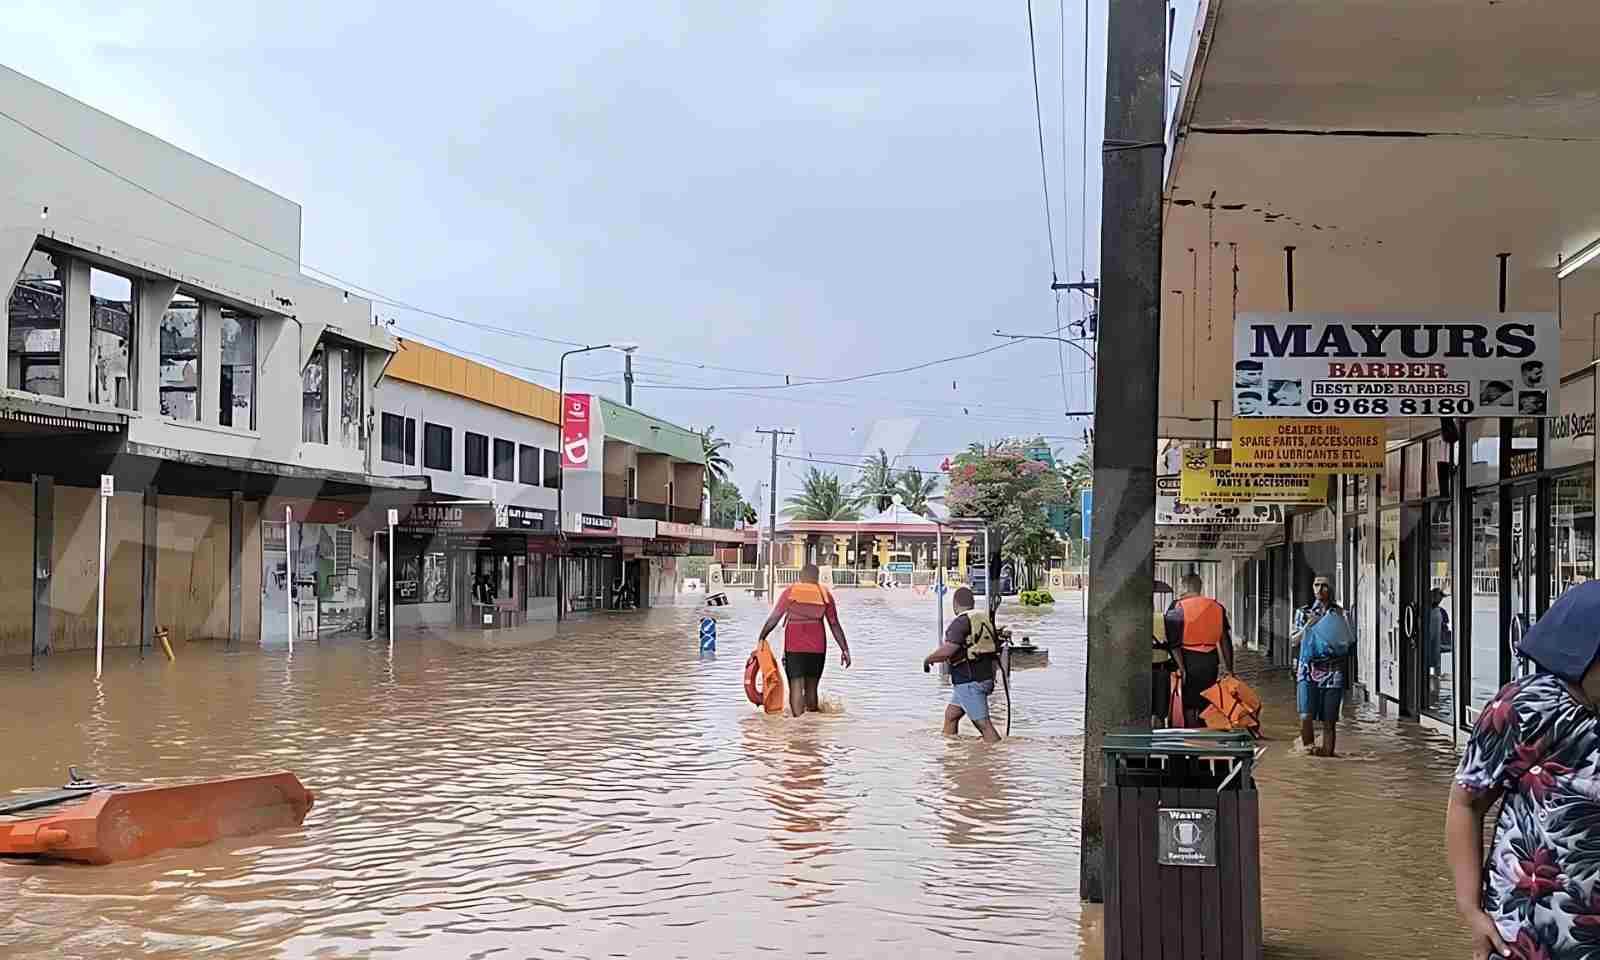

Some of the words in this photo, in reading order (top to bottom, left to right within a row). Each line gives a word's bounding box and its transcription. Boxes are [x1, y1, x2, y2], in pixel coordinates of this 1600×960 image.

[1250, 323, 1537, 358] MAYURS
[1328, 362, 1448, 378] BARBER
[1315, 384, 1350, 394] BEST
[1357, 384, 1393, 394] FADE
[1398, 384, 1465, 395] BARBERS
[1399, 399, 1475, 415] 8180
[1278, 425, 1322, 434] DEALERS
[1240, 436, 1270, 446] SPARE
[1310, 436, 1378, 446] ACCESSORIES
[1254, 449, 1274, 459] AND
[1277, 449, 1339, 459] LUBRICANTS
[1216, 479, 1242, 487] PARTS
[1253, 479, 1309, 487] ACCESSORIES
